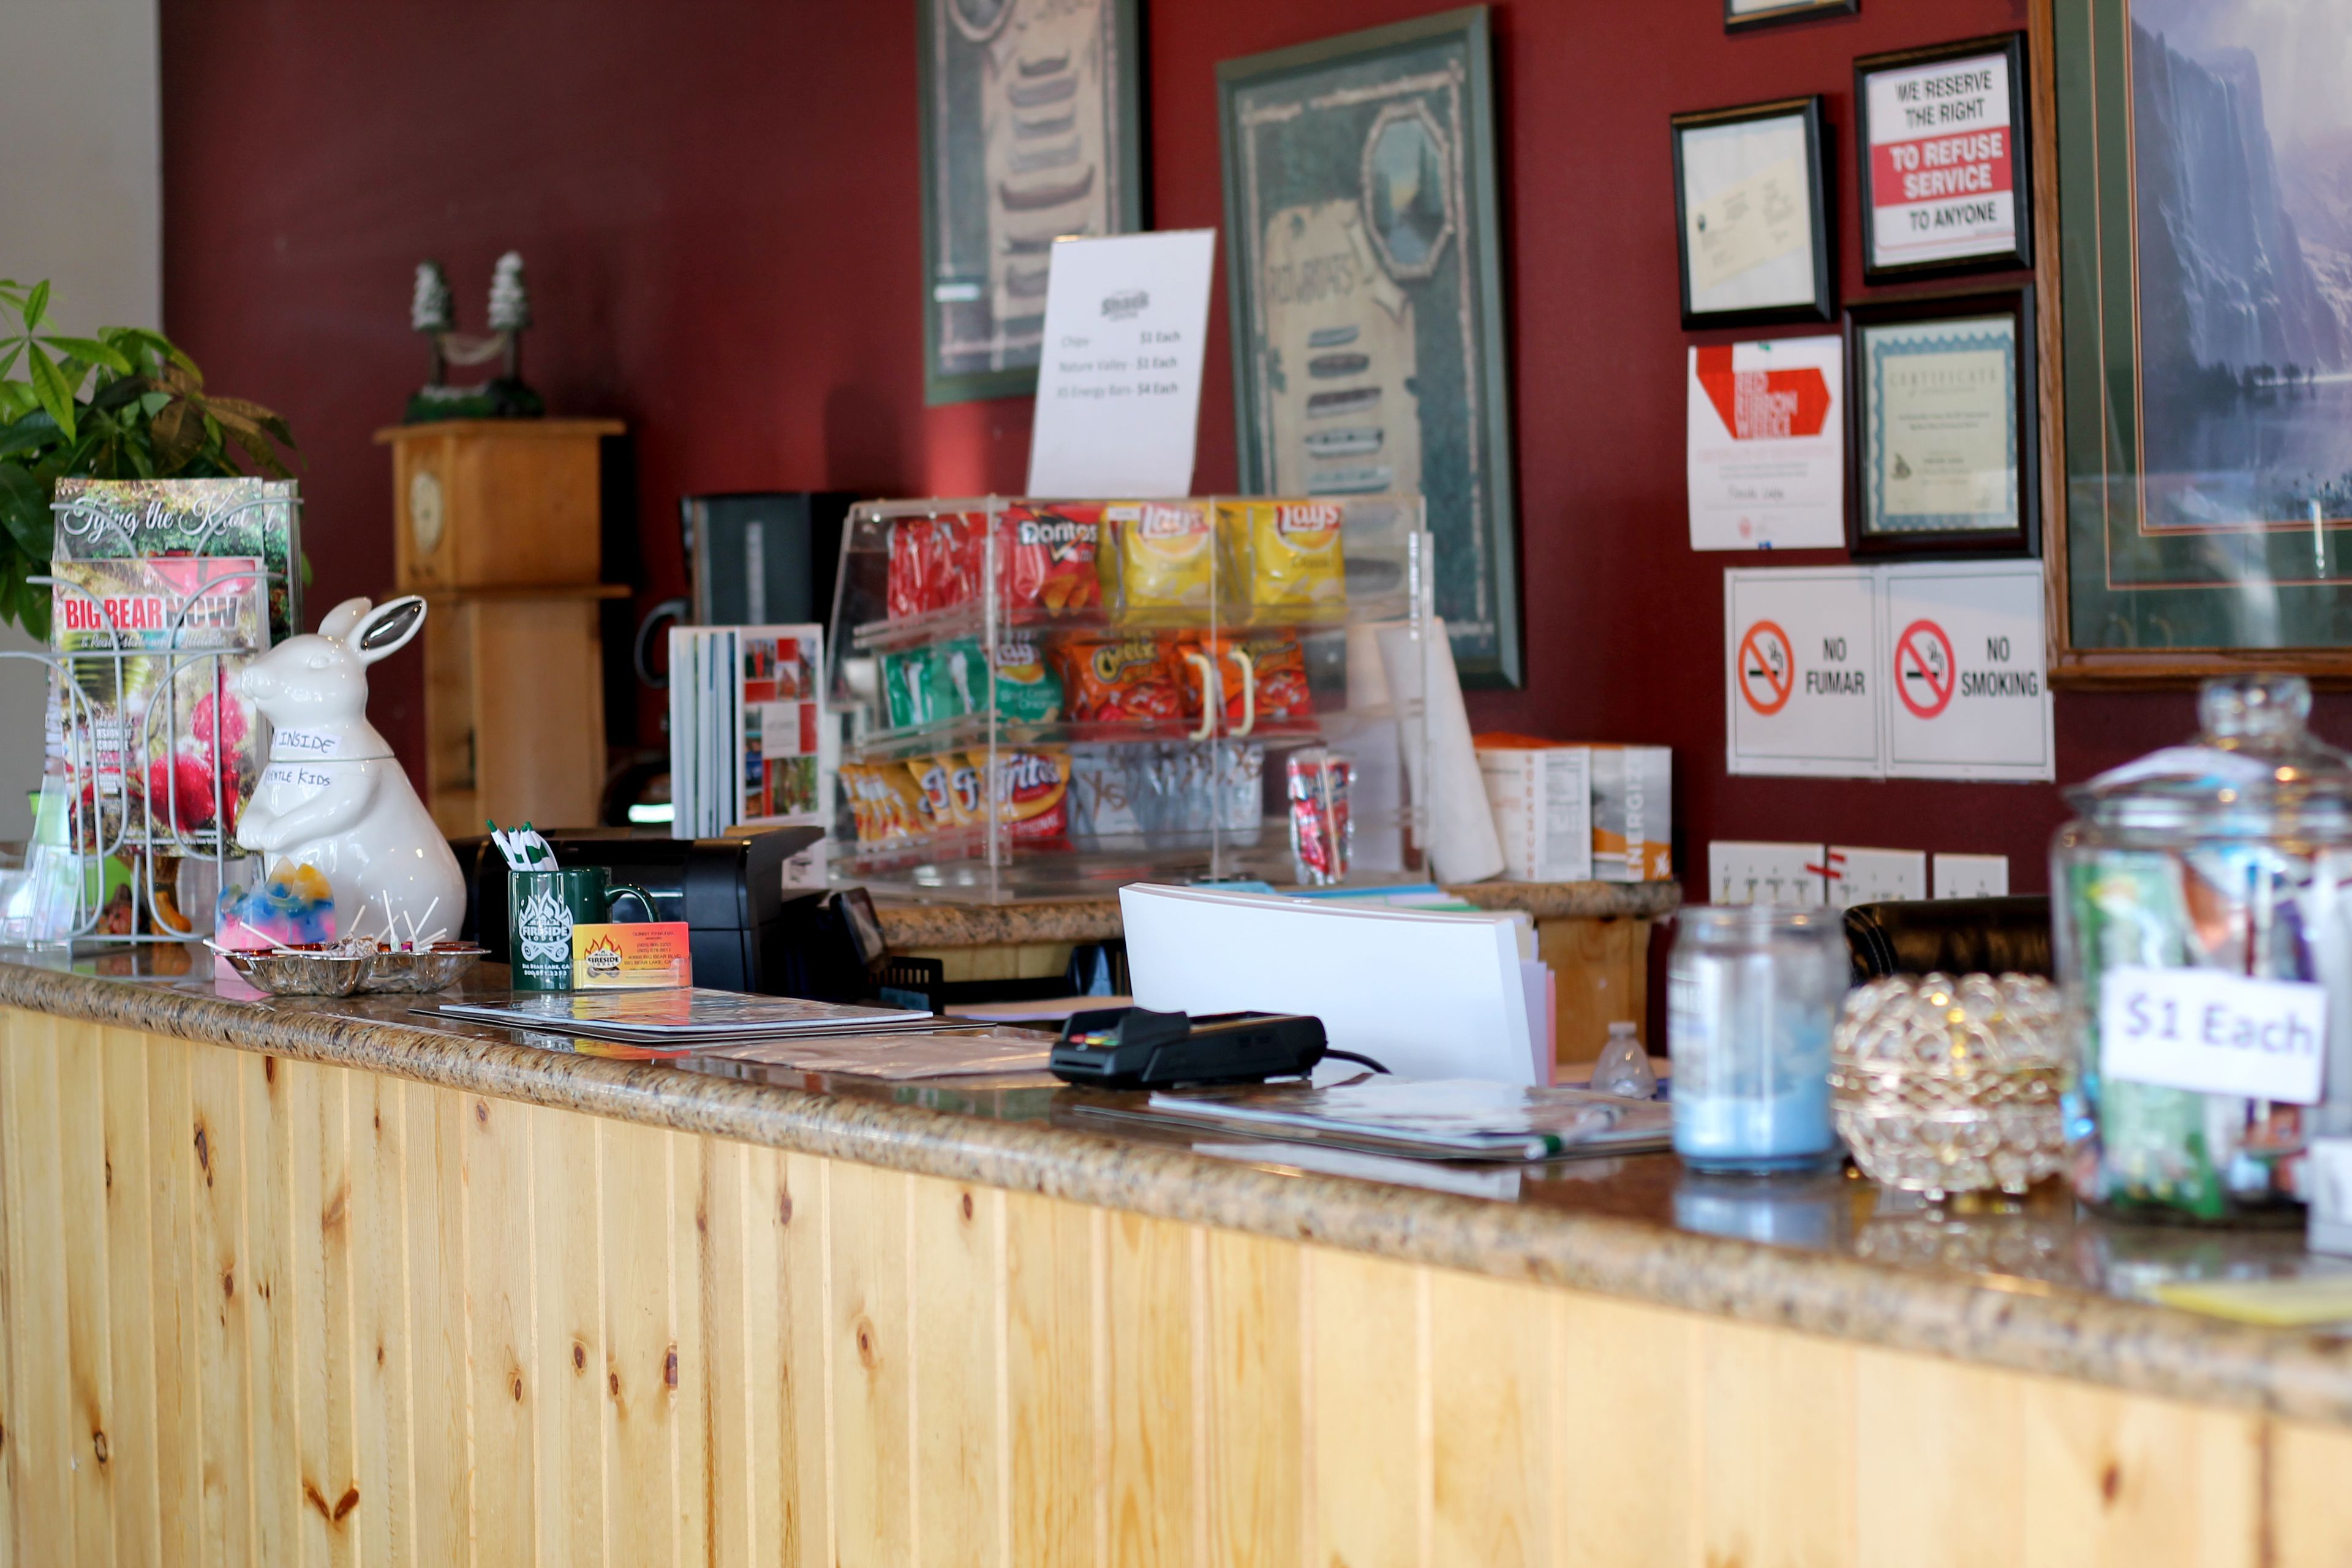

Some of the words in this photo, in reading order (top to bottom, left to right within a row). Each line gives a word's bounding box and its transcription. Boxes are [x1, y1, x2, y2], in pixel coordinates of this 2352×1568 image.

[1896, 80, 1921, 102] WE
[1925, 70, 1992, 99] RESERVE
[1905, 105, 1936, 128] THE
[1940, 97, 1985, 123] RIGHT
[1890, 144, 1920, 173] TO
[1923, 132, 2003, 167] REFUSE
[1903, 163, 1993, 200] SERVICE
[1909, 209, 1929, 230] TO
[1935, 200, 1997, 227] ANYONE
[1156, 330, 1181, 343] Each
[1059, 361, 1093, 372] Nature
[1097, 358, 1127, 372] Valley
[1153, 356, 1177, 369] Each
[1154, 381, 1178, 394] Each
[146, 502, 173, 530] the
[1020, 520, 1098, 545] Doritos
[65, 599, 100, 630] BIG
[104, 598, 163, 630] BEAR
[166, 597, 238, 629] NOW
[1823, 636, 1847, 662] NO
[1986, 636, 2011, 662] NO
[1806, 671, 1866, 695] FUMAR
[1961, 671, 2040, 697] SMOKING
[279, 730, 336, 754] INSIDE
[522, 925, 568, 937] FIRESIDE
[2124, 991, 2179, 1039] $1
[2201, 1002, 2315, 1056] Each
